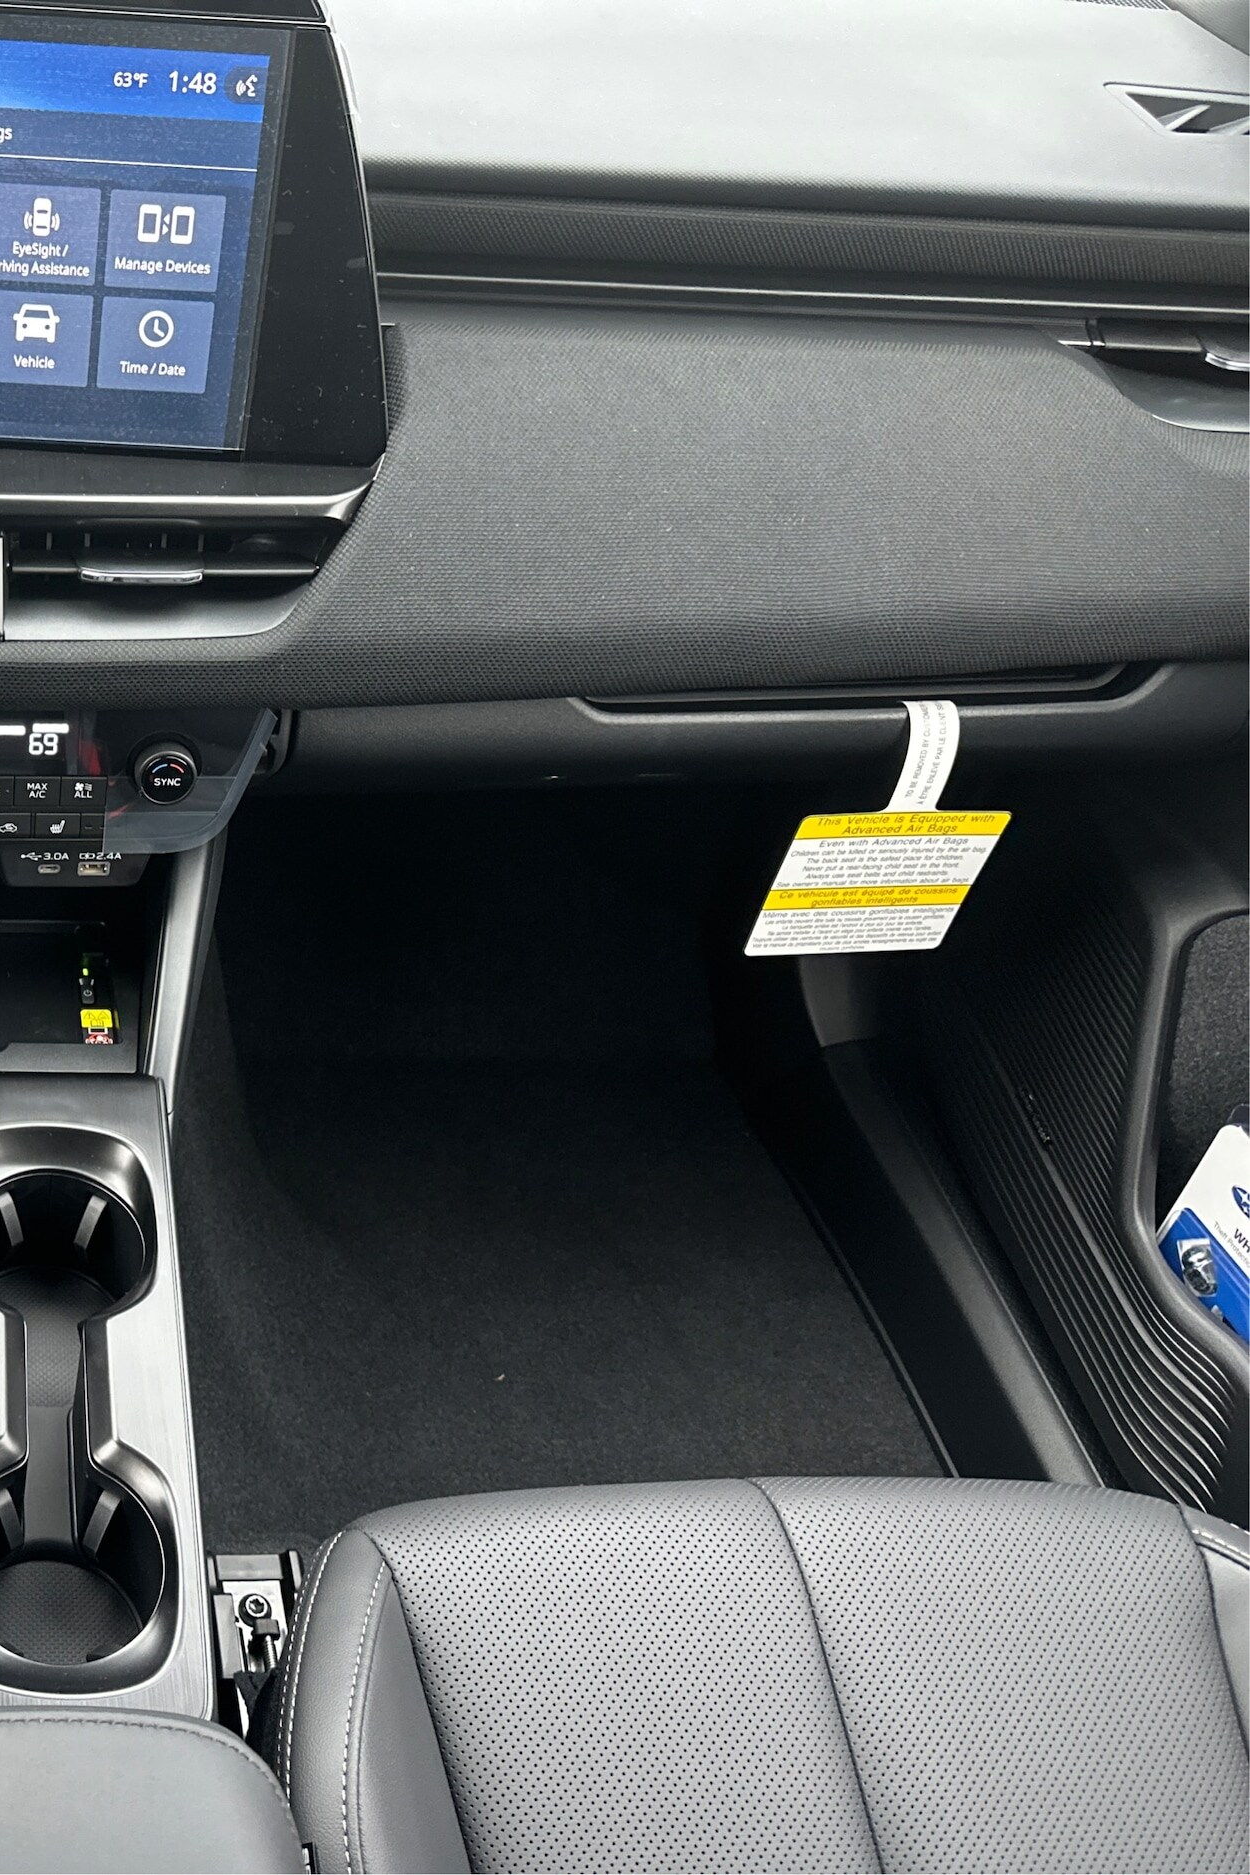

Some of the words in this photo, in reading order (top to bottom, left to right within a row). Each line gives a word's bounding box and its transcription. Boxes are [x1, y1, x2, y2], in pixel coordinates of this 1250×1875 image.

[168, 70, 217, 94] 1:48
[12, 241, 60, 259] EyeSight
[31, 262, 90, 277] Assistance
[114, 257, 163, 273] Manage
[165, 260, 211, 275] Devices
[13, 354, 55, 369] Vehicle
[120, 361, 148, 375] Time
[158, 363, 186, 376] Date
[29, 733, 58, 755] 69
[27, 783, 48, 791] MAX
[153, 778, 181, 787] SYNC
[28, 790, 46, 799] A/C
[74, 790, 92, 799] ALL
[818, 817, 841, 826] This
[847, 816, 890, 825] Vehicle
[894, 815, 905, 823] is
[910, 814, 966, 826] Equipped
[971, 814, 995, 823] with
[842, 826, 902, 835] Advanced
[905, 825, 923, 833] Air
[927, 825, 958, 835] Bags
[819, 840, 844, 848] Even
[872, 838, 922, 846] Advanced
[943, 838, 968, 846] Bags
[43, 852, 69, 861] 3.0A
[96, 852, 122, 861] 2.4A
[779, 891, 794, 899] Ce
[797, 890, 839, 898] véhicule
[861, 888, 895, 897] équipé
[898, 887, 911, 895] de
[914, 887, 958, 895] coussins
[810, 897, 862, 908] gonflables
[865, 896, 918, 905] intelligents
